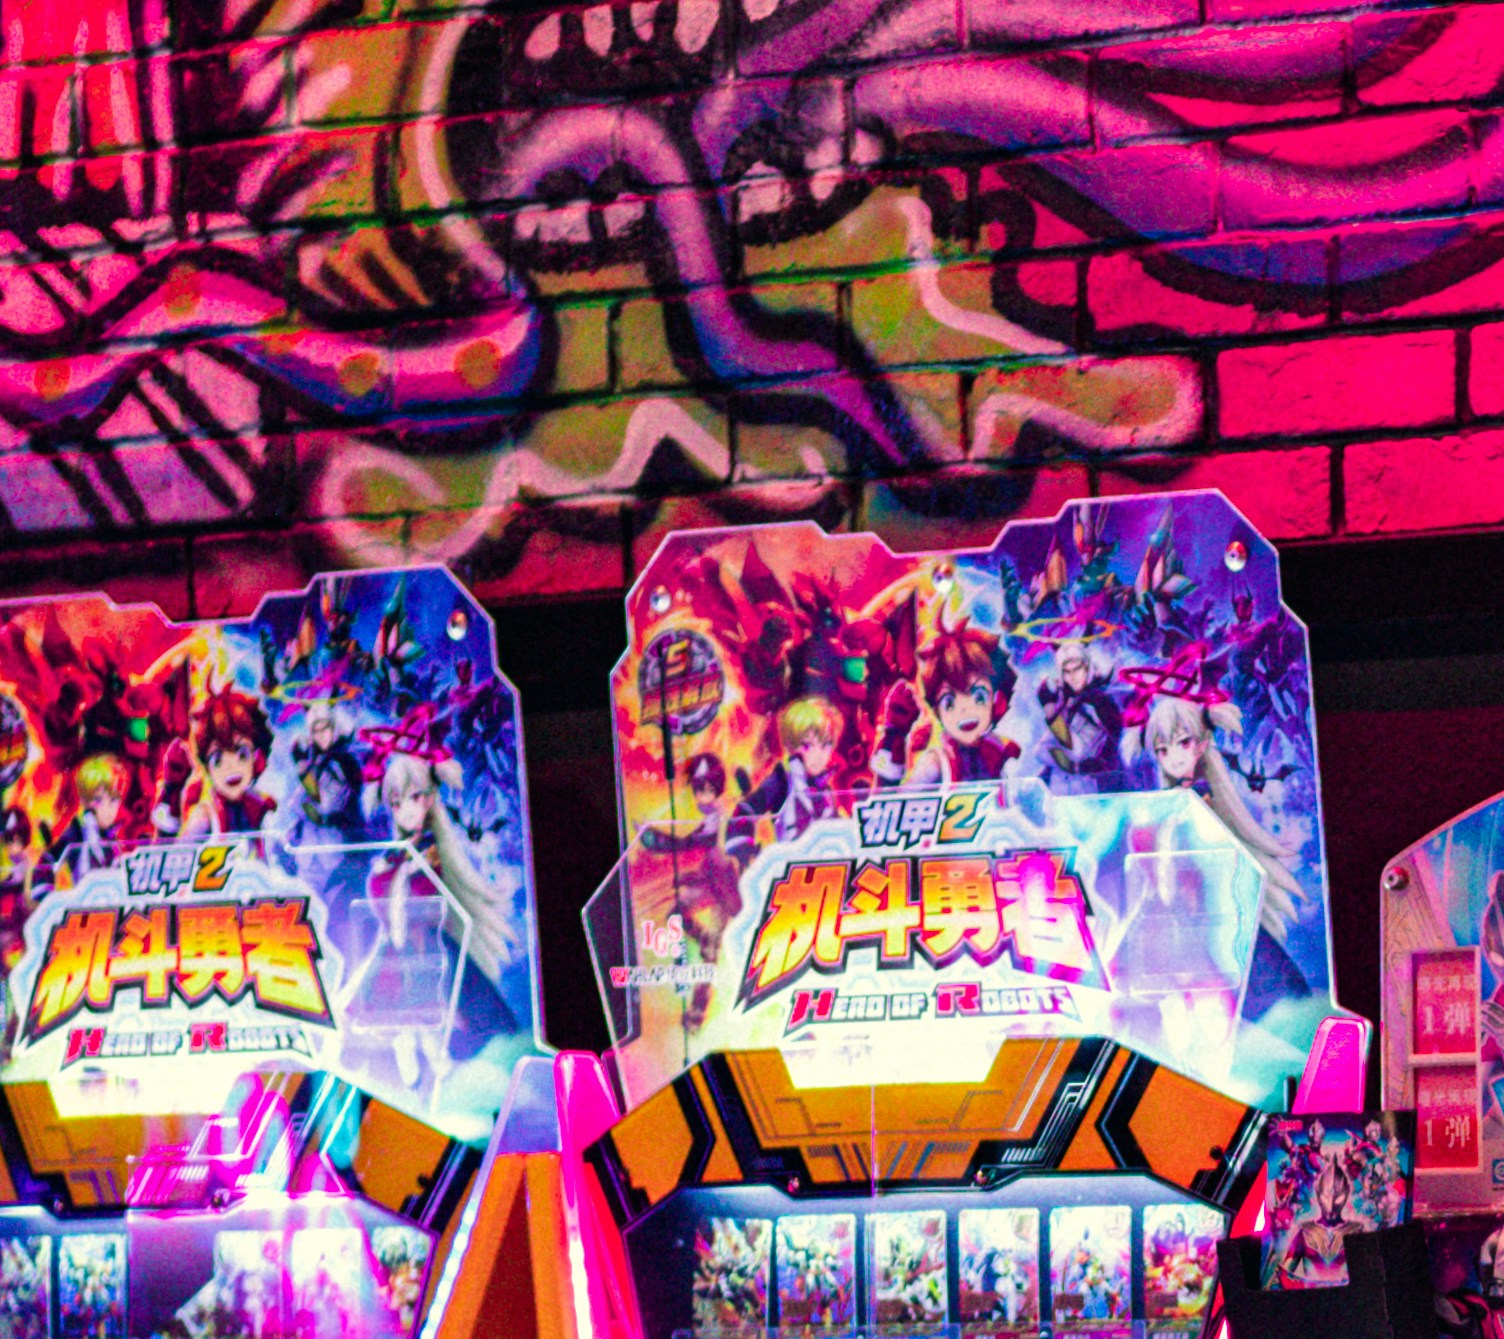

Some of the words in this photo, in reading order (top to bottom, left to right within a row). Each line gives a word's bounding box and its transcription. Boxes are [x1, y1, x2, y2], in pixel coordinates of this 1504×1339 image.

[858, 793, 986, 851] 机甲2
[31, 901, 326, 1025] 机斗勇者
[753, 852, 1101, 992] 机斗勇者
